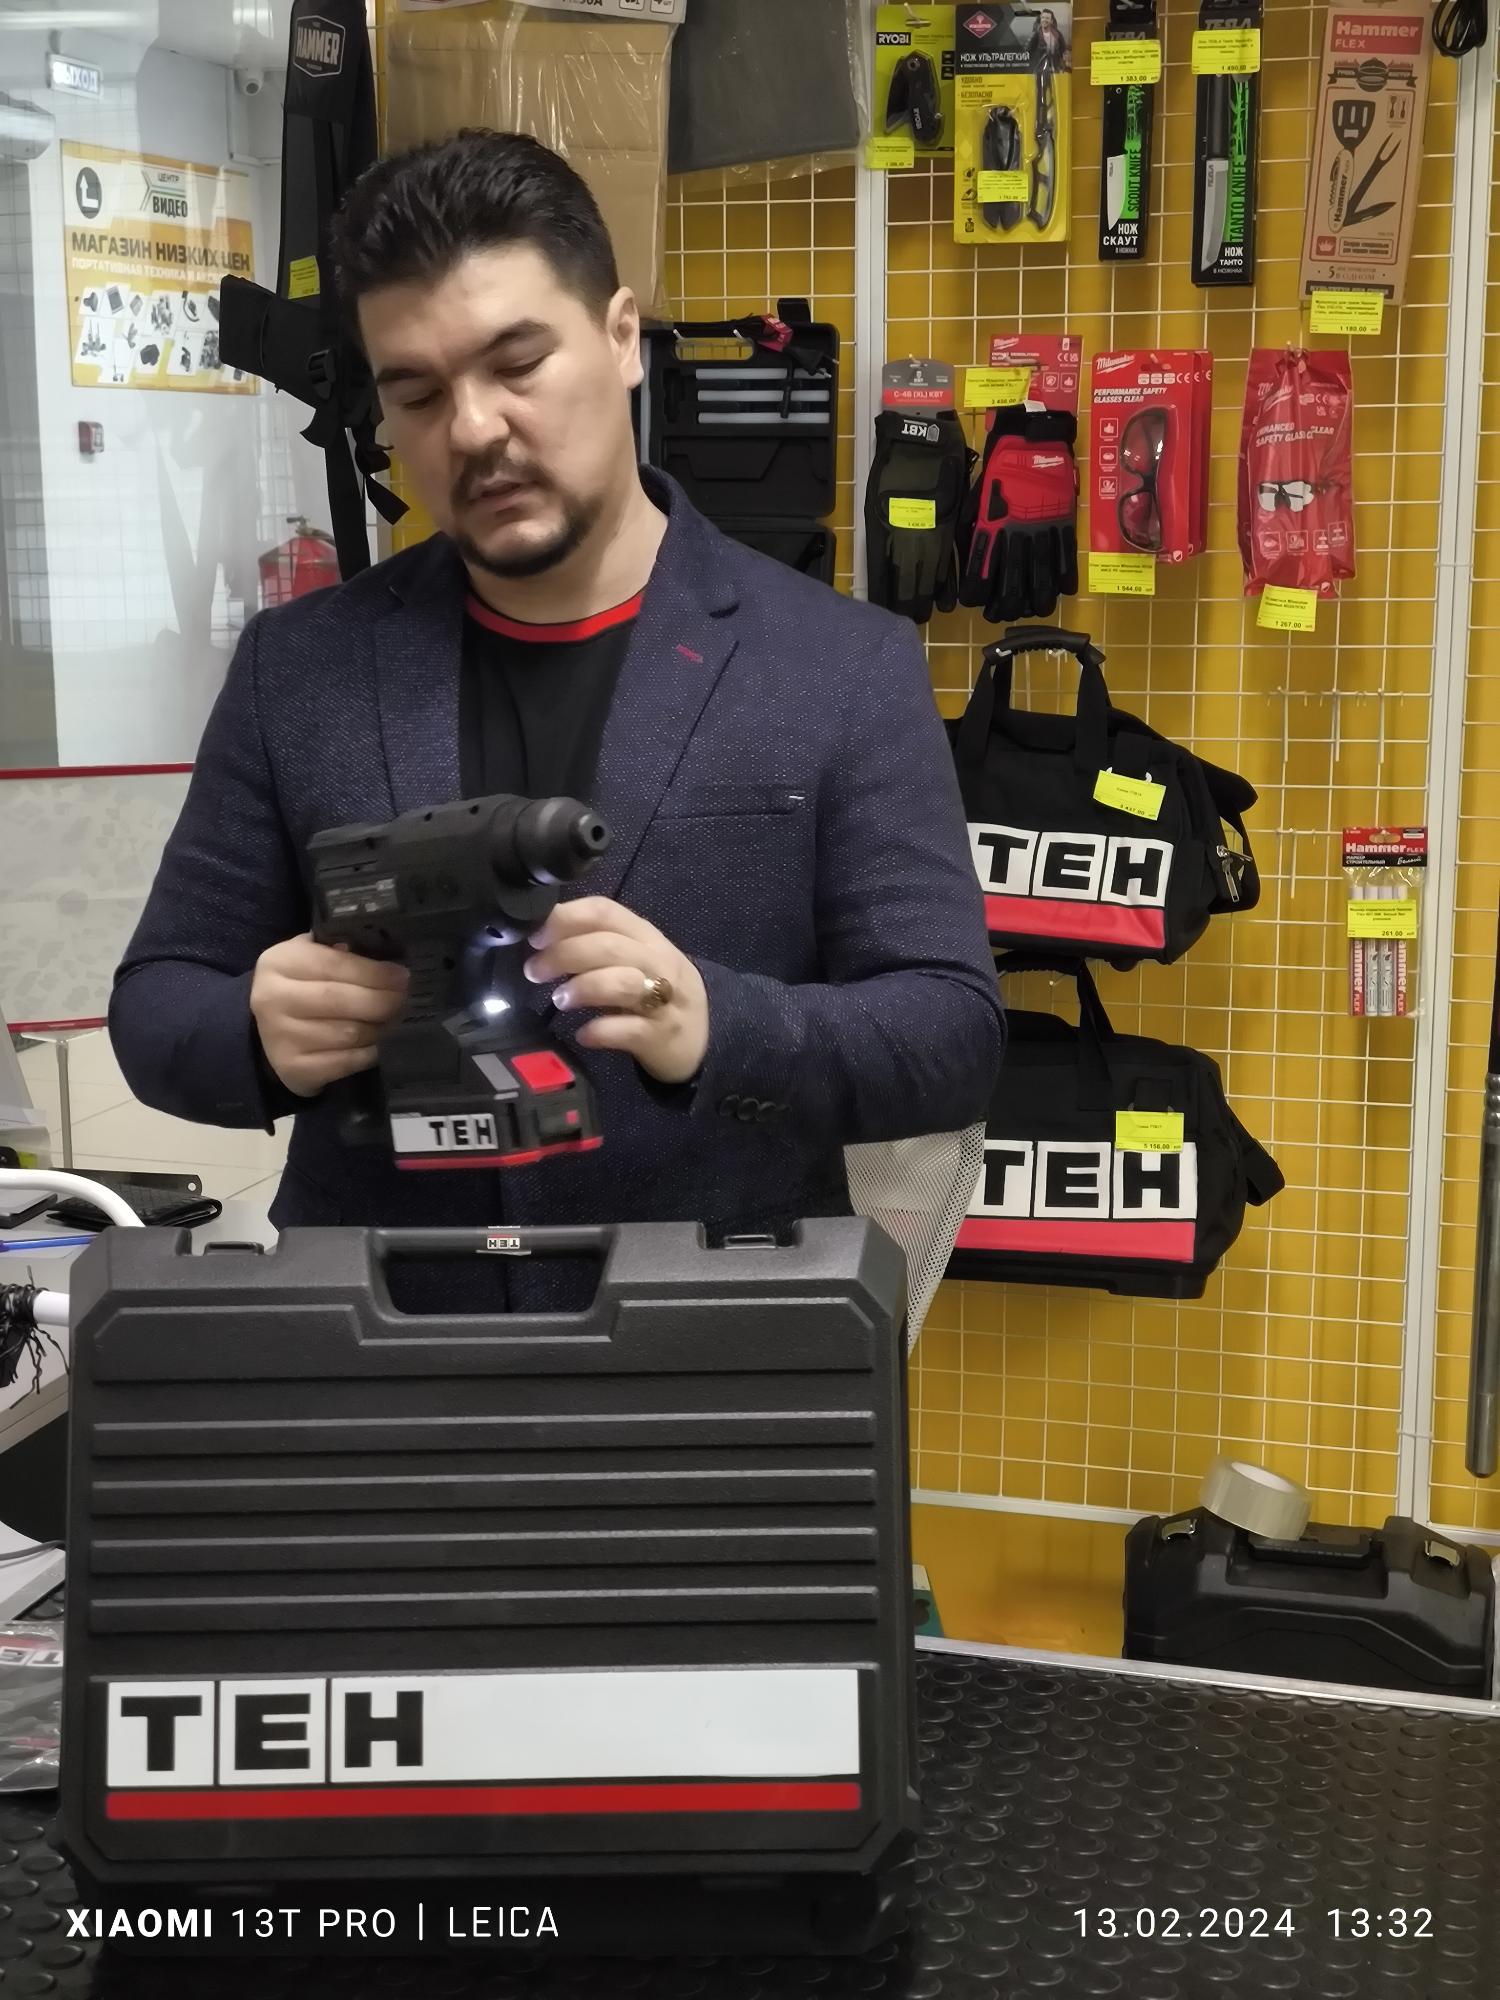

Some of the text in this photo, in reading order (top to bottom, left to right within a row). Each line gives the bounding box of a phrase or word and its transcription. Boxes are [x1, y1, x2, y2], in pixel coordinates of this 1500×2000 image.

[1335, 20, 1419, 38] Hammer
[295, 26, 341, 66] HAMMER
[877, 33, 910, 45] RYOBI
[1334, 38, 1367, 49] FLEX
[960, 52, 977, 62] НОЖ
[1128, 148, 1141, 178] KNIFE
[157, 172, 181, 184] ЦЕНТР
[1231, 160, 1247, 198] KNIFE
[1127, 180, 1141, 212] SCOUT
[1333, 174, 1348, 222] Hammer
[152, 196, 188, 218] ВИДЕО
[1117, 223, 1139, 235] НОЖ
[1229, 201, 1246, 242] TANTO
[1102, 235, 1138, 246] СКАУТ
[71, 231, 251, 272] МАГАЗИН НИЗКИХ ЦЕН
[1224, 246, 1244, 257] НОЖ
[1219, 259, 1244, 267] ТАНТО
[1093, 386, 1168, 397] PERFORMANCE SAFETY
[1123, 395, 1145, 403] CLEAR
[1345, 842, 1407, 853] Hammer
[1353, 939, 1363, 993] ammer
[1398, 939, 1407, 993] ammer
[120, 1690, 424, 1772] TEH
